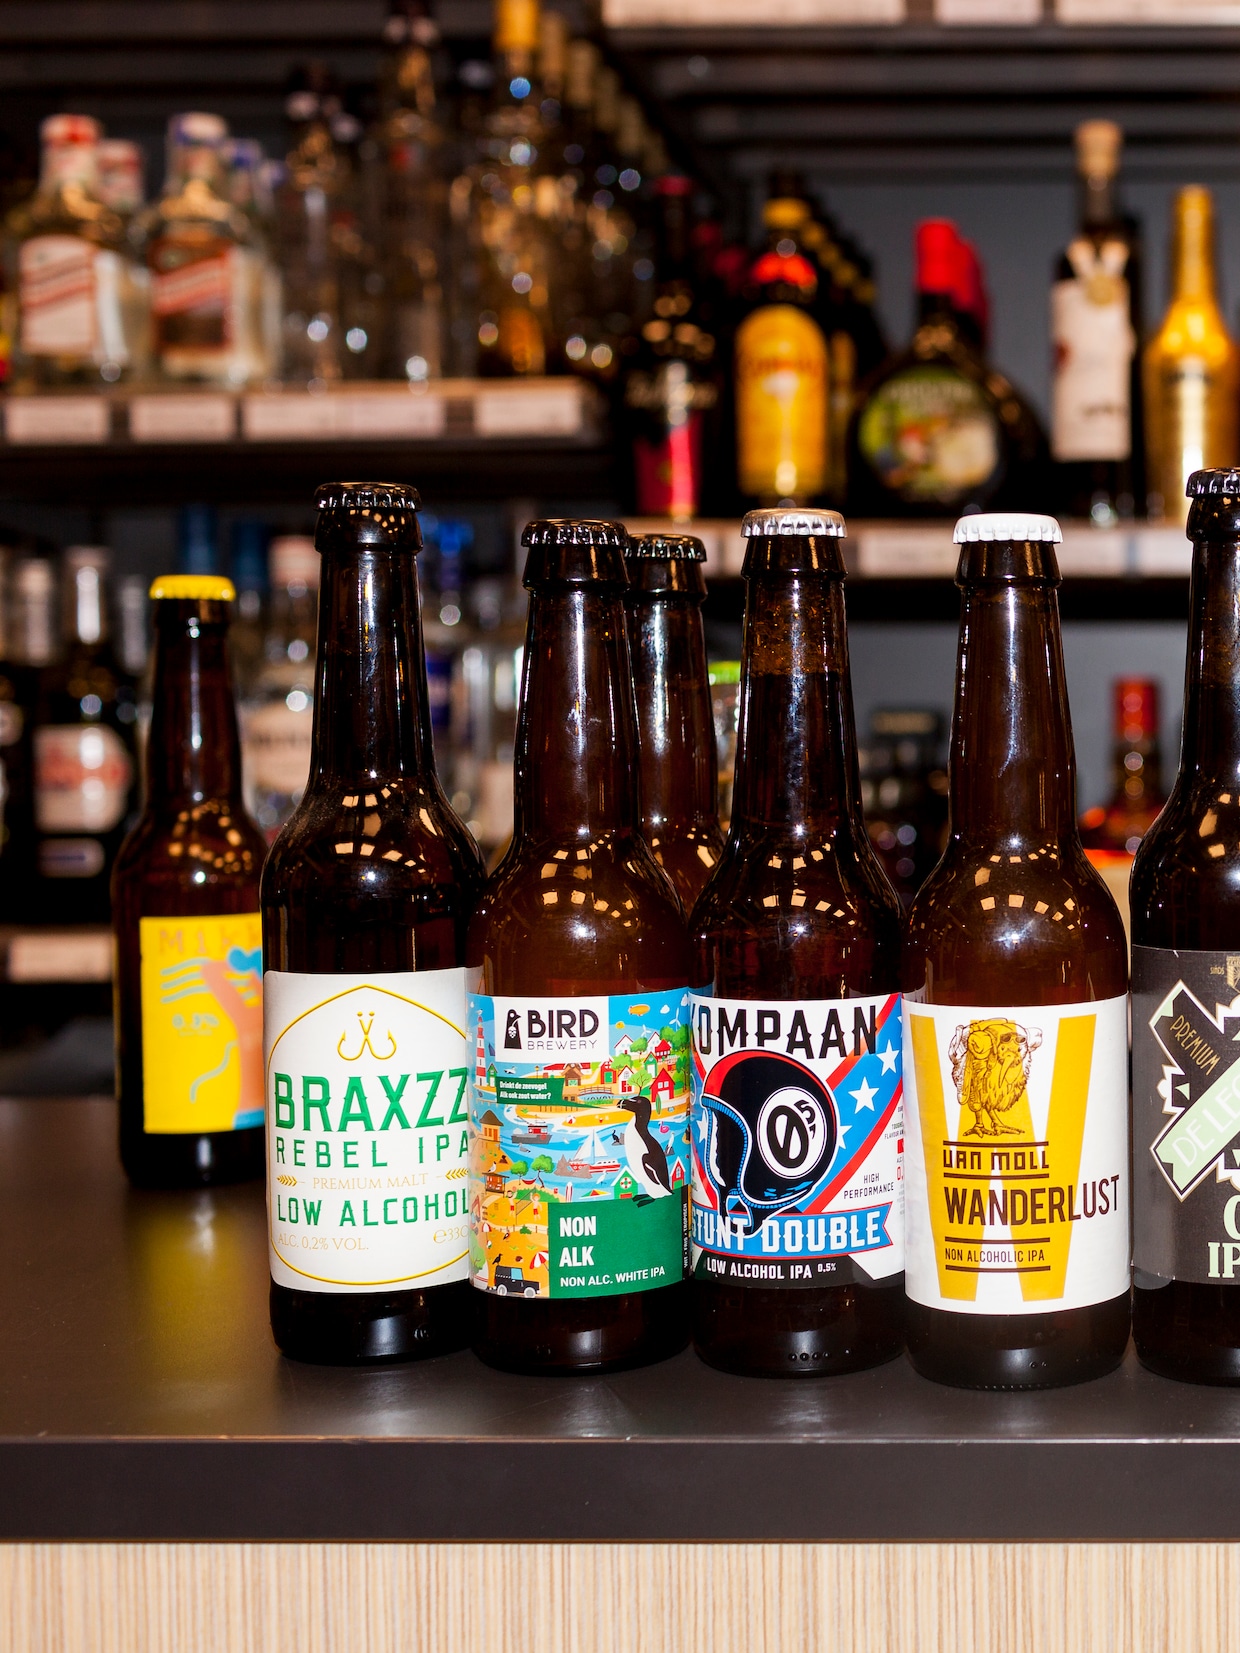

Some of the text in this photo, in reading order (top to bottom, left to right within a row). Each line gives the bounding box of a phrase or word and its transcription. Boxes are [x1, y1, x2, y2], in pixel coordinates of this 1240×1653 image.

[527, 1009, 600, 1038] BIRD
[691, 1003, 877, 1059] OMPAAN
[527, 1040, 598, 1051] BREWERY
[1169, 1014, 1221, 1076] PREMIUM
[274, 1067, 469, 1132] BRAXZZ
[276, 1130, 469, 1168] REBEL IPA
[1171, 1117, 1212, 1169] DE
[312, 1172, 429, 1190] PREMIUM MALT
[863, 1173, 880, 1184] HIGH
[843, 1182, 894, 1200] PERFORMANCE
[943, 1174, 1120, 1226] WANDERLUST
[277, 1188, 469, 1226] LOW ALCOHOL
[559, 1216, 597, 1237] NON
[759, 1210, 881, 1253] DOUBLE
[277, 1234, 299, 1247] ALC.
[331, 1237, 369, 1251] VOL.
[559, 1246, 594, 1267] ALK
[945, 1247, 1045, 1263] NON ALCOHOLIC IPA
[560, 1266, 666, 1287] NON ALC. WHITE IPA
[706, 1257, 727, 1274] LOW
[729, 1261, 785, 1280] ALCOHOL
[790, 1263, 812, 1279] IPA
